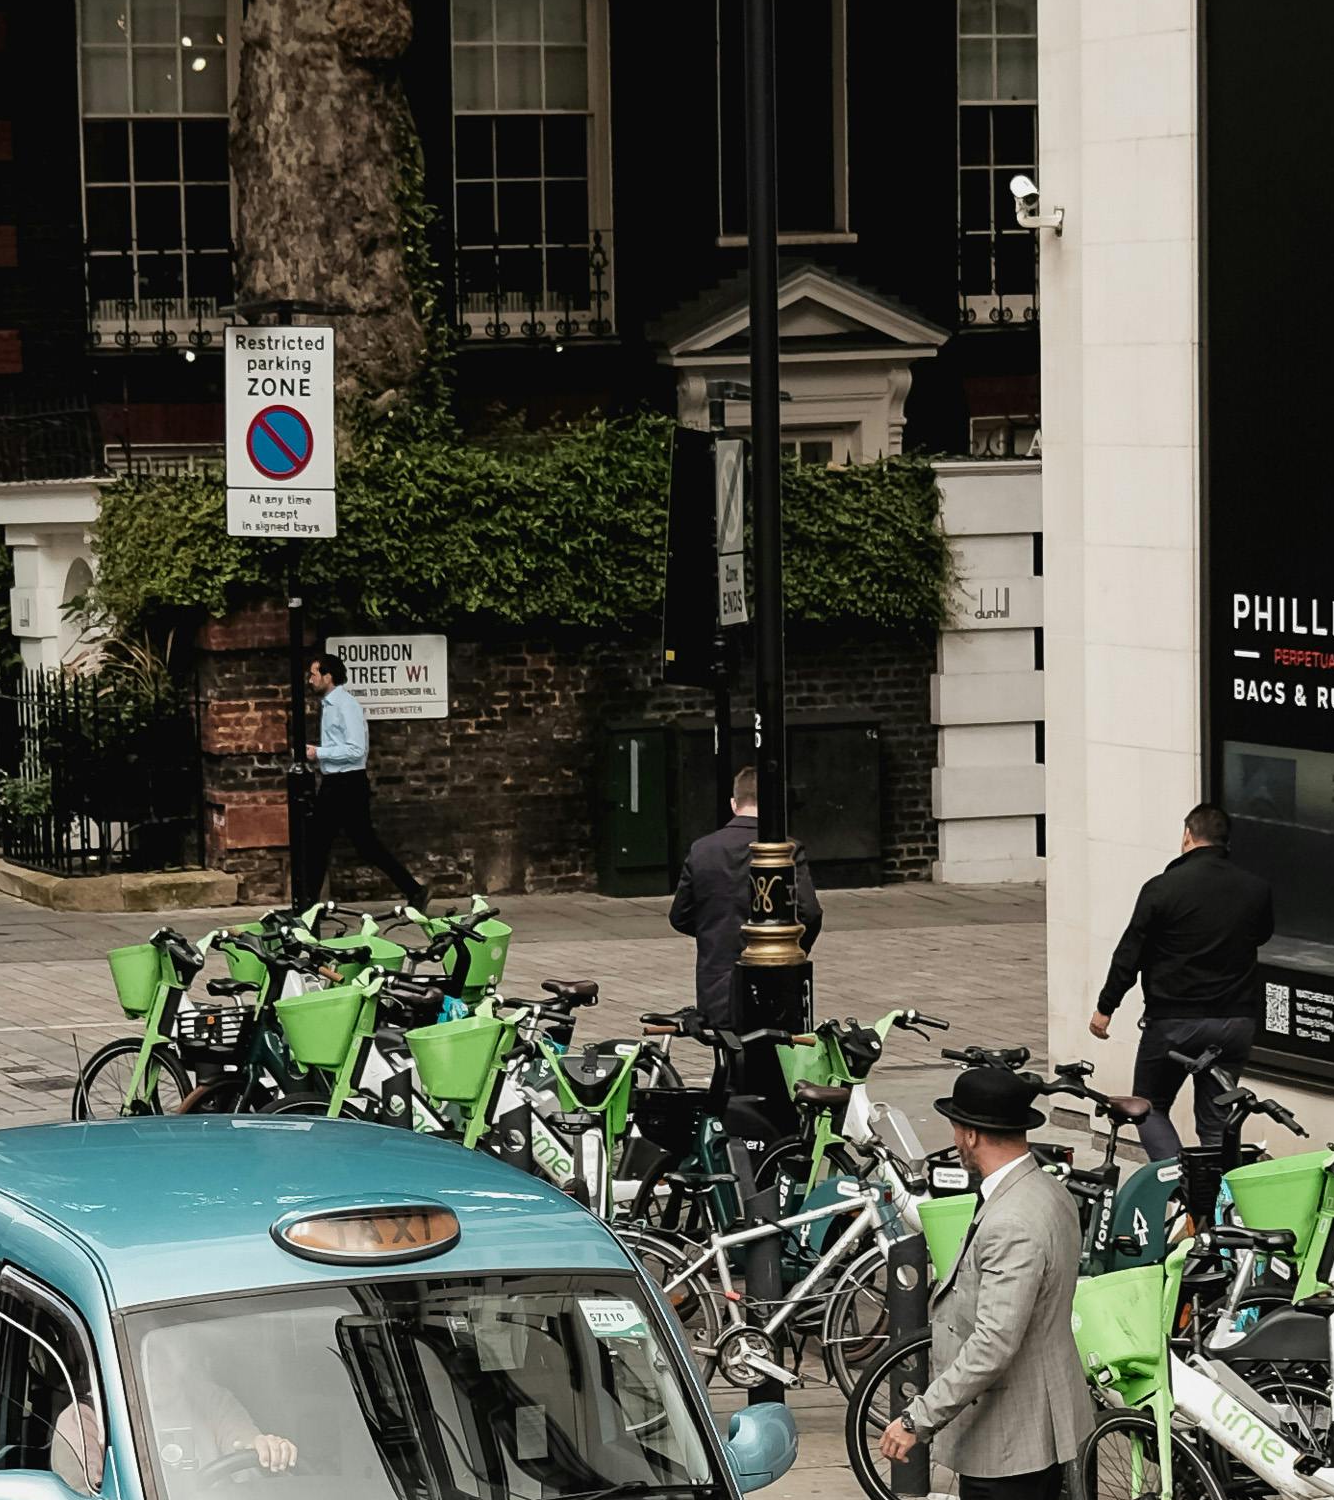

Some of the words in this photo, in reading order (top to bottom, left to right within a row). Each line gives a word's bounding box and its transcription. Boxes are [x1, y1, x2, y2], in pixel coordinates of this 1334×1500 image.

[235, 334, 325, 351] Restricted
[247, 355, 311, 374] parking
[247, 377, 311, 397] ZONE
[249, 494, 261, 505] At
[264, 496, 284, 506] any
[287, 495, 312, 505] time
[261, 509, 299, 520] except
[242, 521, 252, 531] in
[255, 521, 290, 534] signed
[293, 522, 320, 534] bays
[723, 588, 743, 615] ENDS
[974, 587, 1010, 620] dunhill
[338, 644, 412, 662] BOURDON
[348, 666, 397, 684] TREET
[405, 665, 429, 683] W1
[1233, 678, 1286, 705] BACS
[1294, 684, 1307, 707] &
[1094, 1188, 1114, 1251] forest
[328, 1213, 431, 1249] TAXI
[589, 1312, 625, 1323] 57110
[1211, 1390, 1285, 1466] Lime
